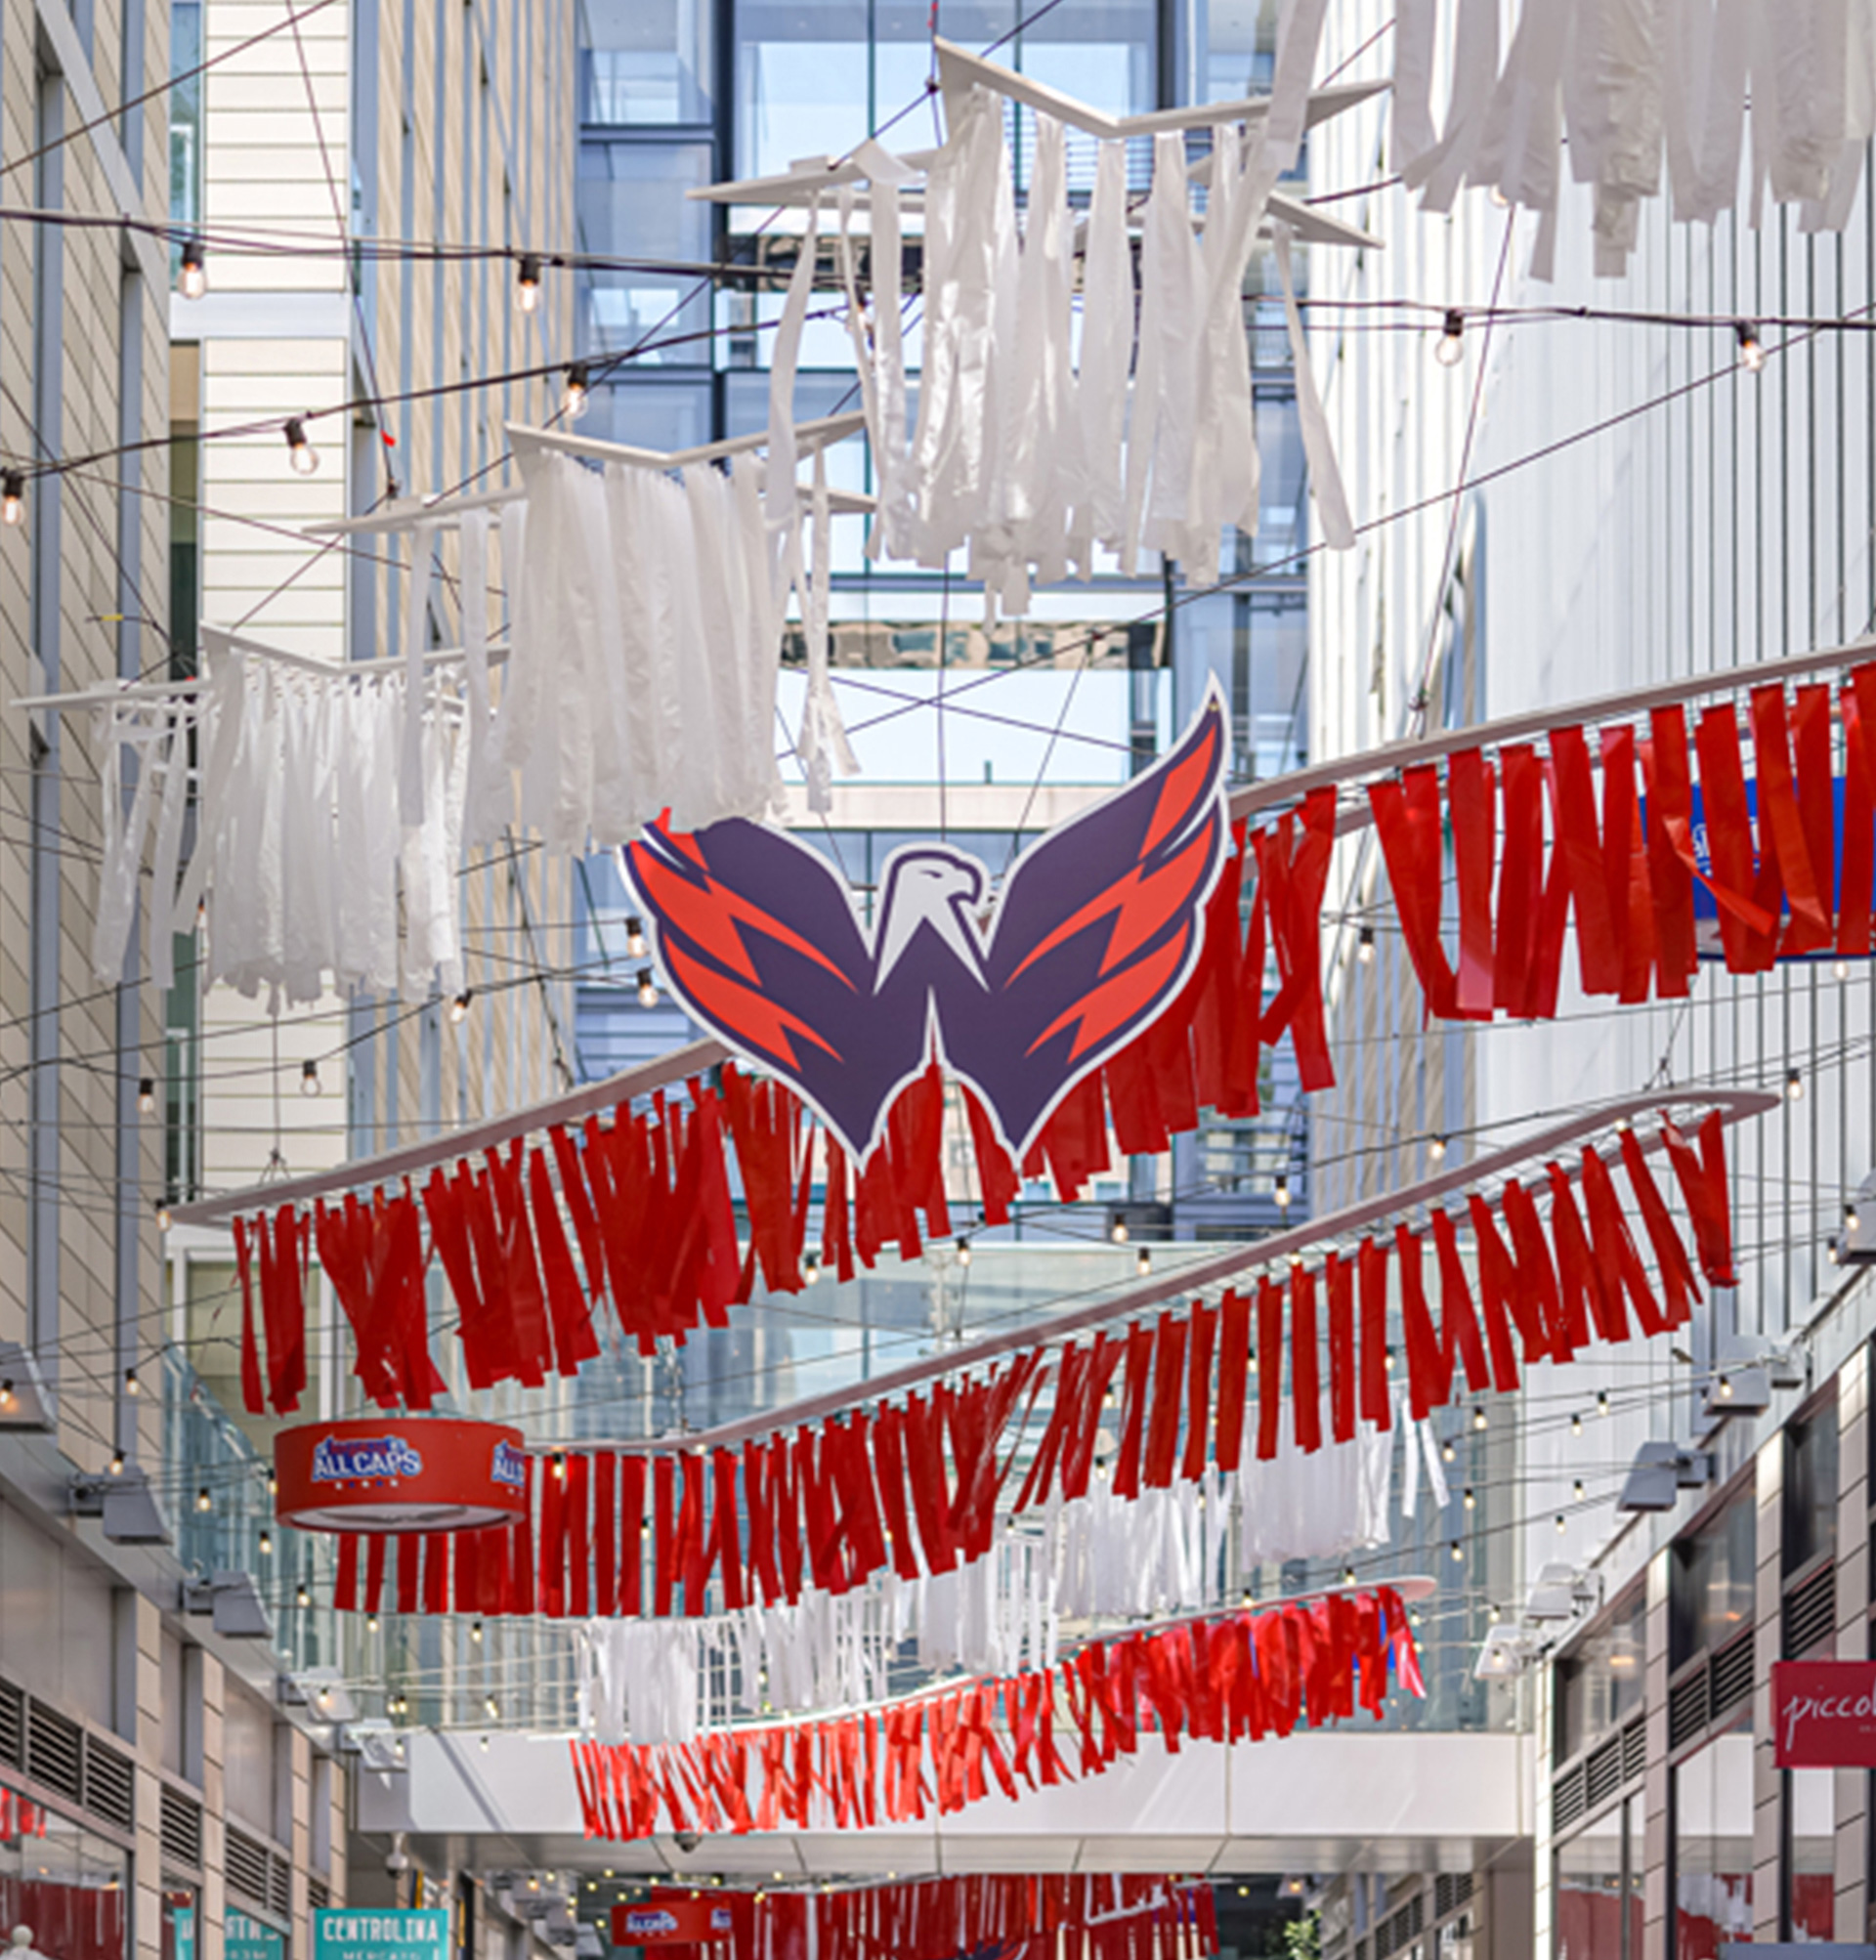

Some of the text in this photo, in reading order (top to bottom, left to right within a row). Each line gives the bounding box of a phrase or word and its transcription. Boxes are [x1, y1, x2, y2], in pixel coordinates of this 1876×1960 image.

[313, 1449, 421, 1478] ALL CAPS
[323, 1916, 439, 1942] CENTROLINA
